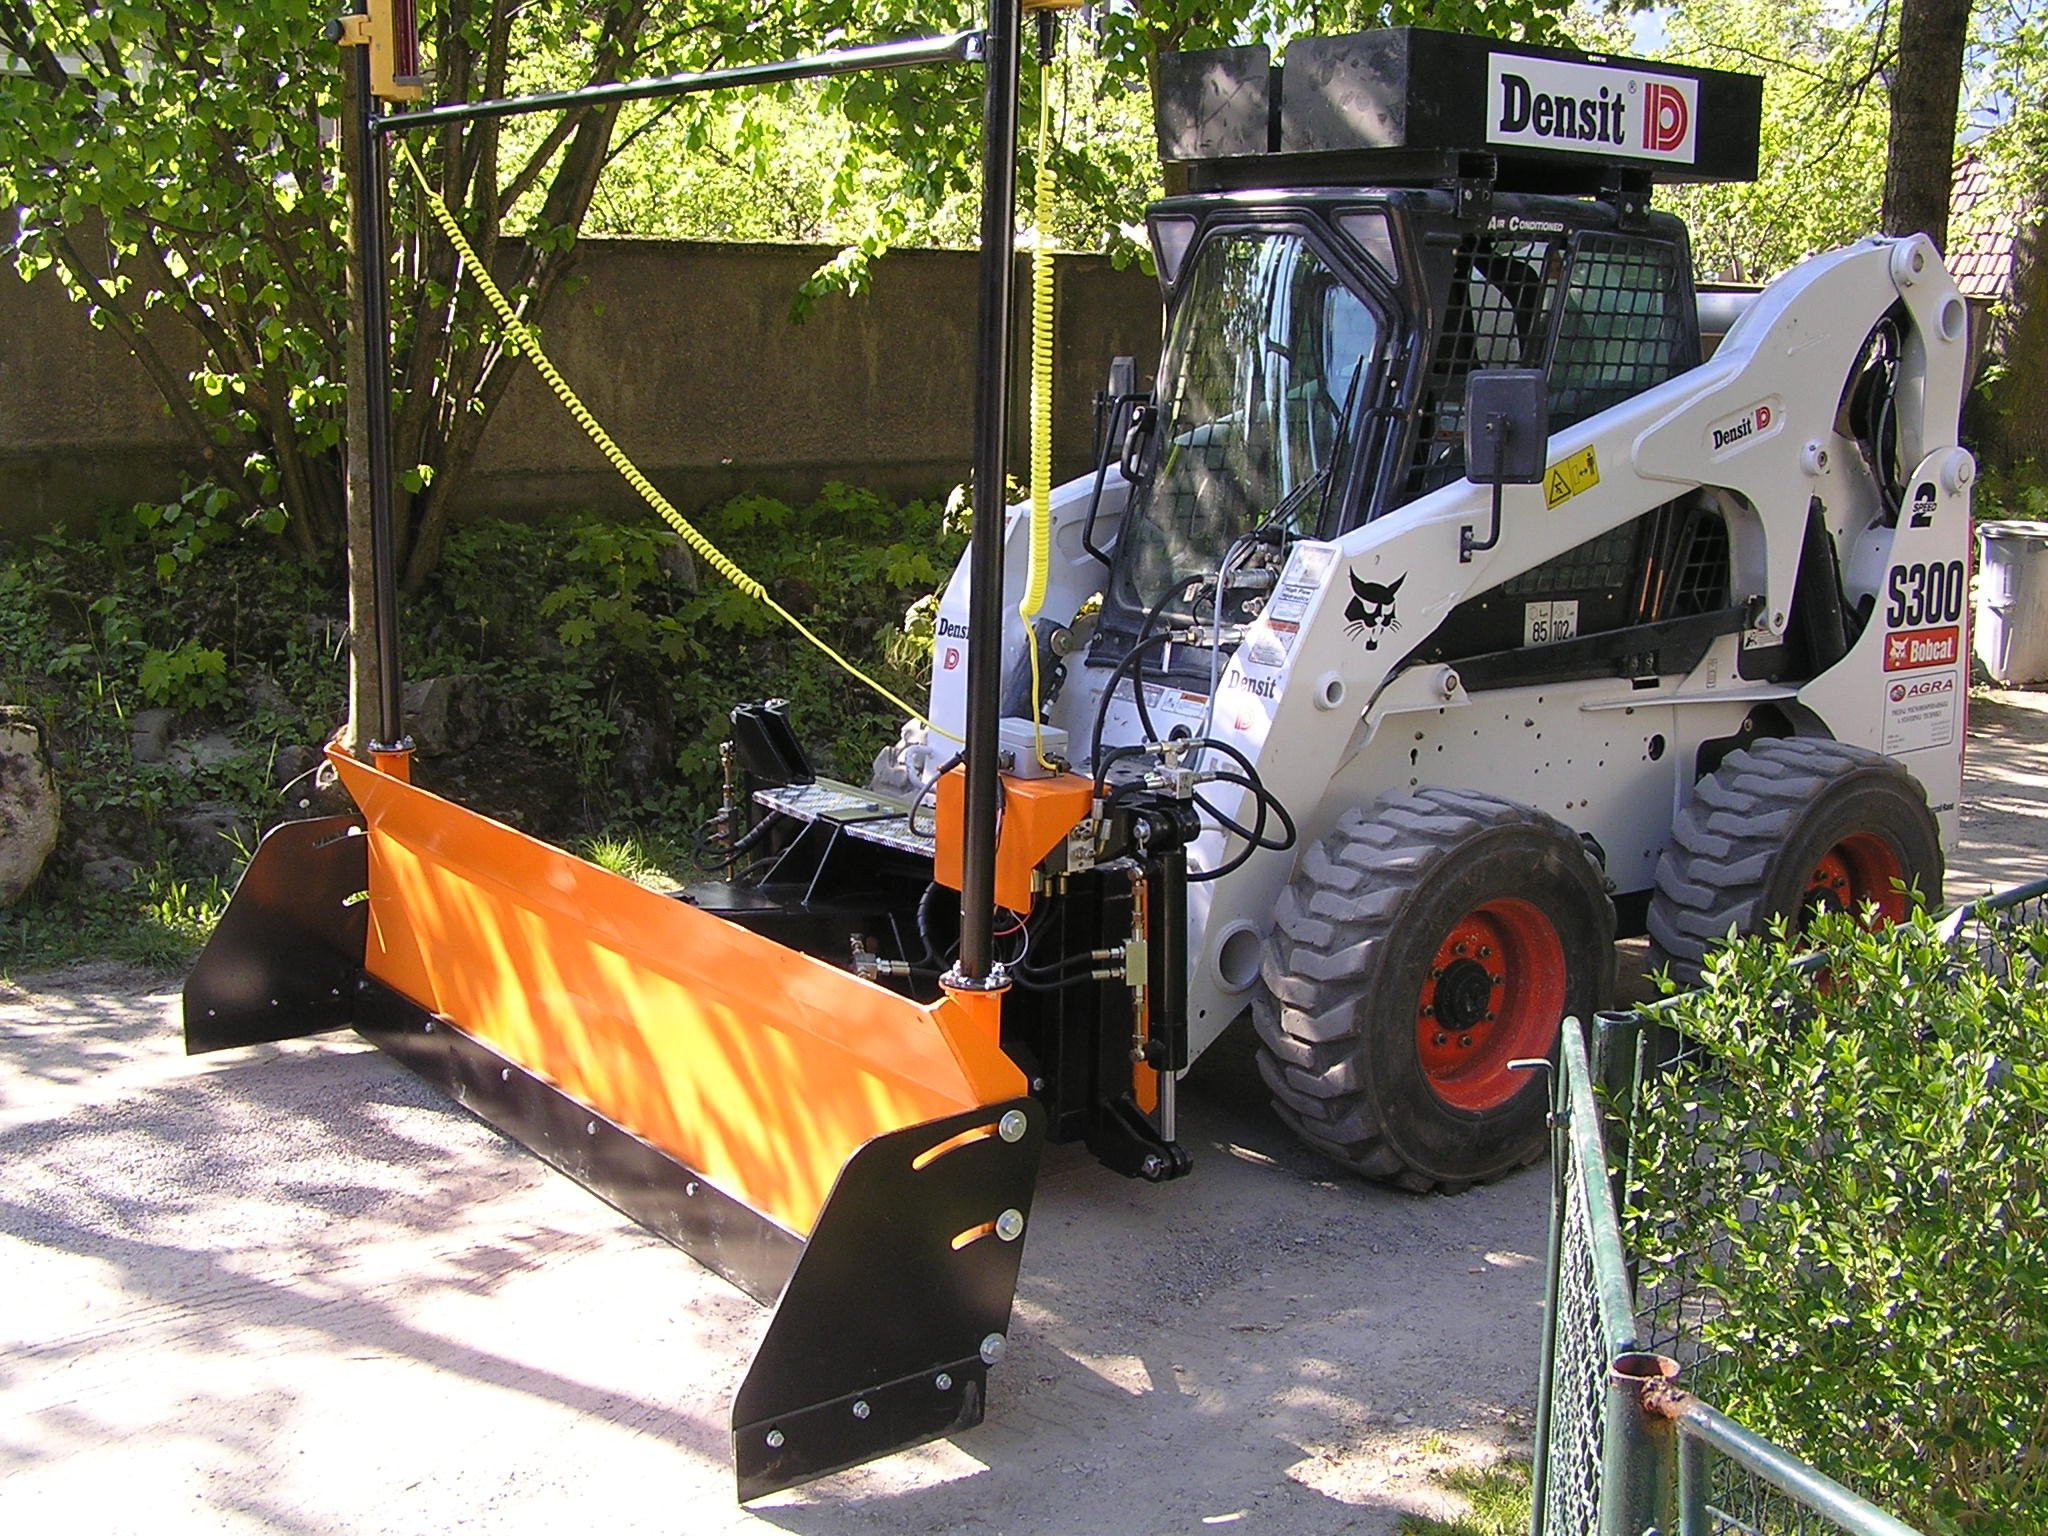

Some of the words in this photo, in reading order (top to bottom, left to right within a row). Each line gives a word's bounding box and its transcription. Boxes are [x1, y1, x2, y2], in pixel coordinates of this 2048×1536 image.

[1500, 73, 1626, 145] Densit
[1713, 418, 1752, 450] Densit
[1912, 502, 1937, 513] SPEED
[1887, 560, 1964, 628] S300
[938, 617, 970, 640] Dens
[1533, 621, 1547, 642] 85
[1553, 620, 1569, 641] 102
[1910, 636, 1952, 663] Bobcat
[1228, 669, 1276, 699] Densit
[1908, 679, 1953, 696] AGRA
